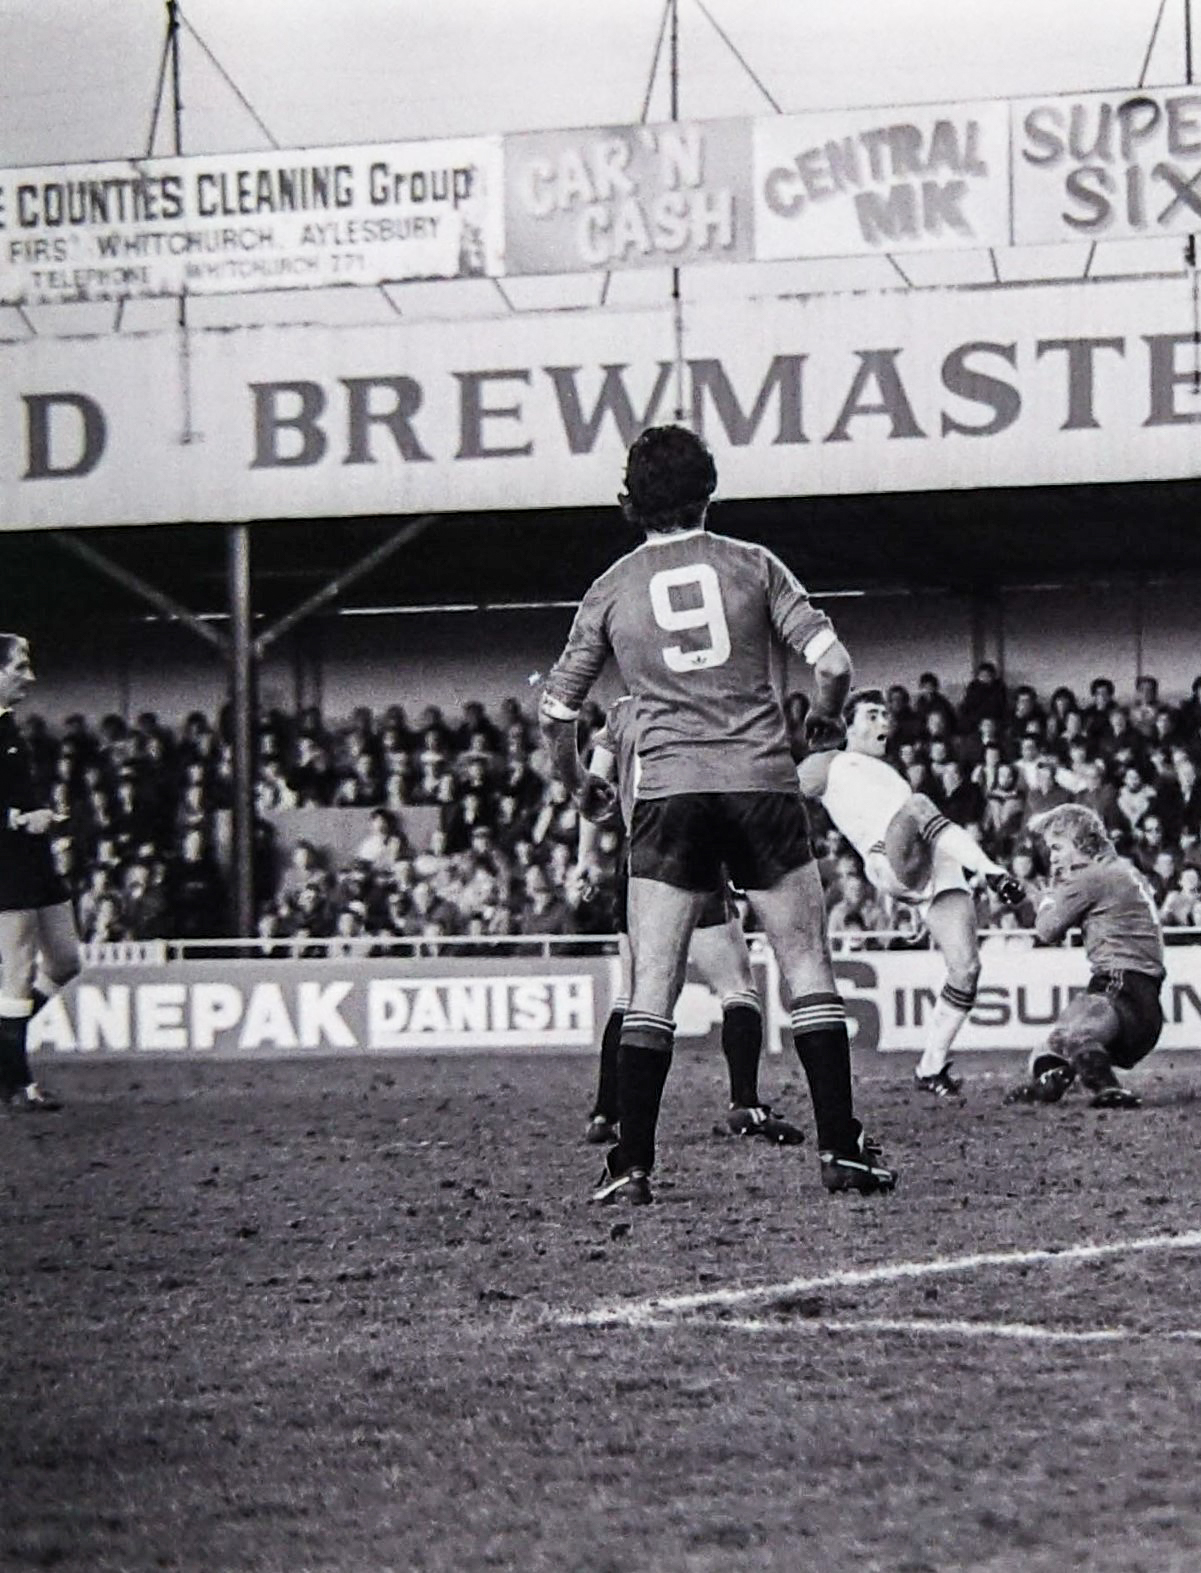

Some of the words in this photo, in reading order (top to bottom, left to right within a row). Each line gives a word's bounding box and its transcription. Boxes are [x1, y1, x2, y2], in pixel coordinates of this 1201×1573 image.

[18, 176, 184, 228] COUNTIES
[198, 165, 353, 217] CLEANING
[370, 162, 473, 209] Group
[764, 120, 987, 218] CENTRAL
[9, 238, 67, 263] FIRS
[301, 216, 441, 246] AYLESBURY
[579, 187, 738, 264] CASH
[854, 180, 975, 247] MK
[20, 392, 109, 480] D
[649, 563, 731, 672] 9
[372, 978, 593, 1032] DANISH
